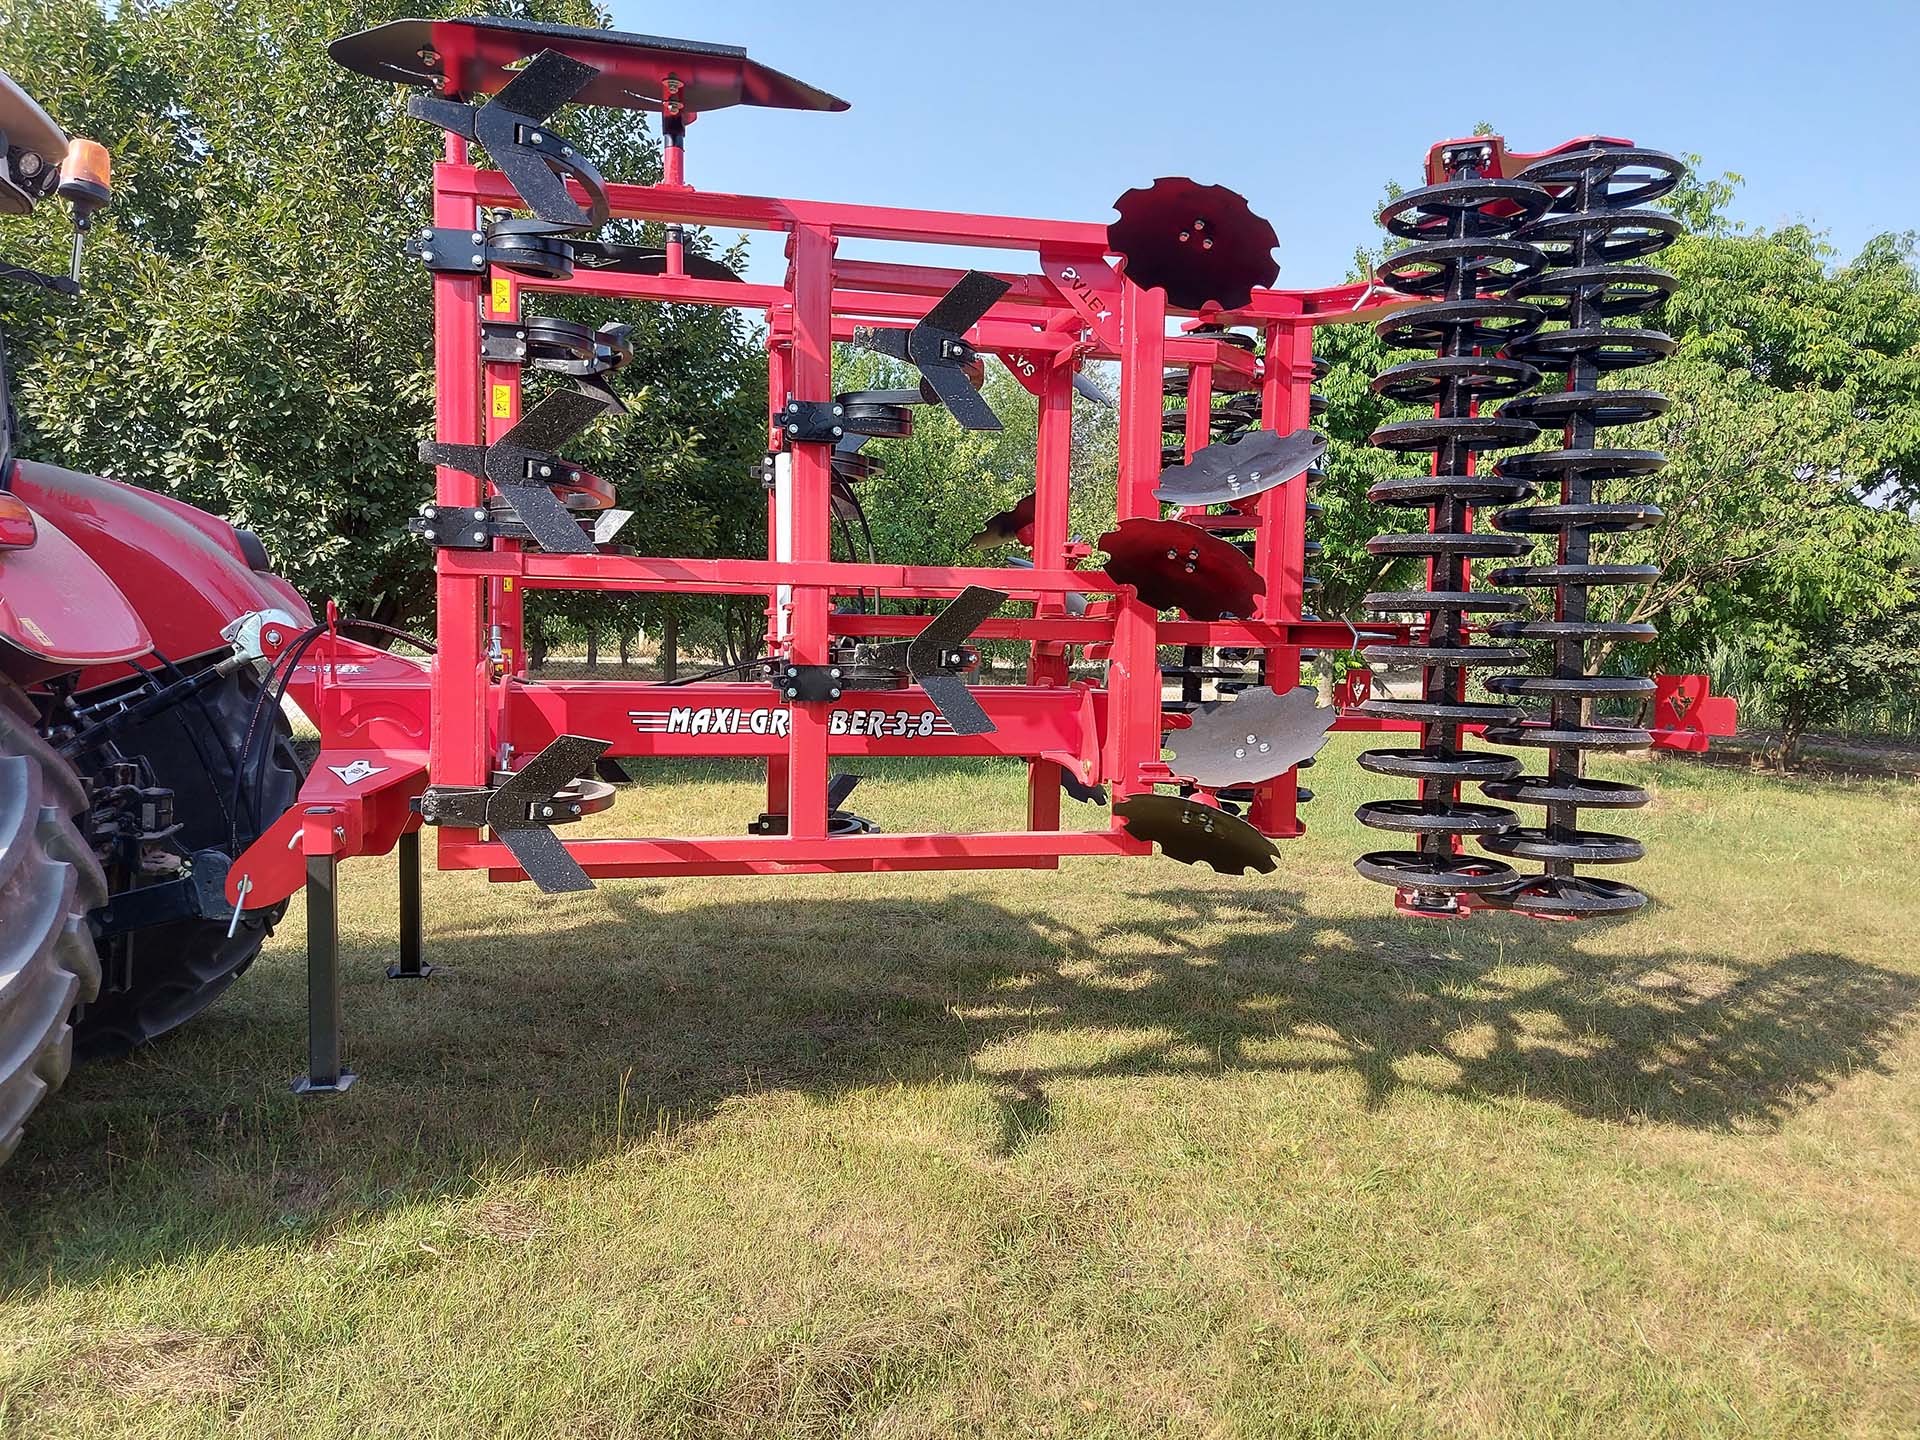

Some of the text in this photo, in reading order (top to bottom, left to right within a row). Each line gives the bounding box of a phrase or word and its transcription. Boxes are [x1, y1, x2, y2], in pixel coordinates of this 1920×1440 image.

[667, 707, 935, 739] MAXI GRBER 3,8
